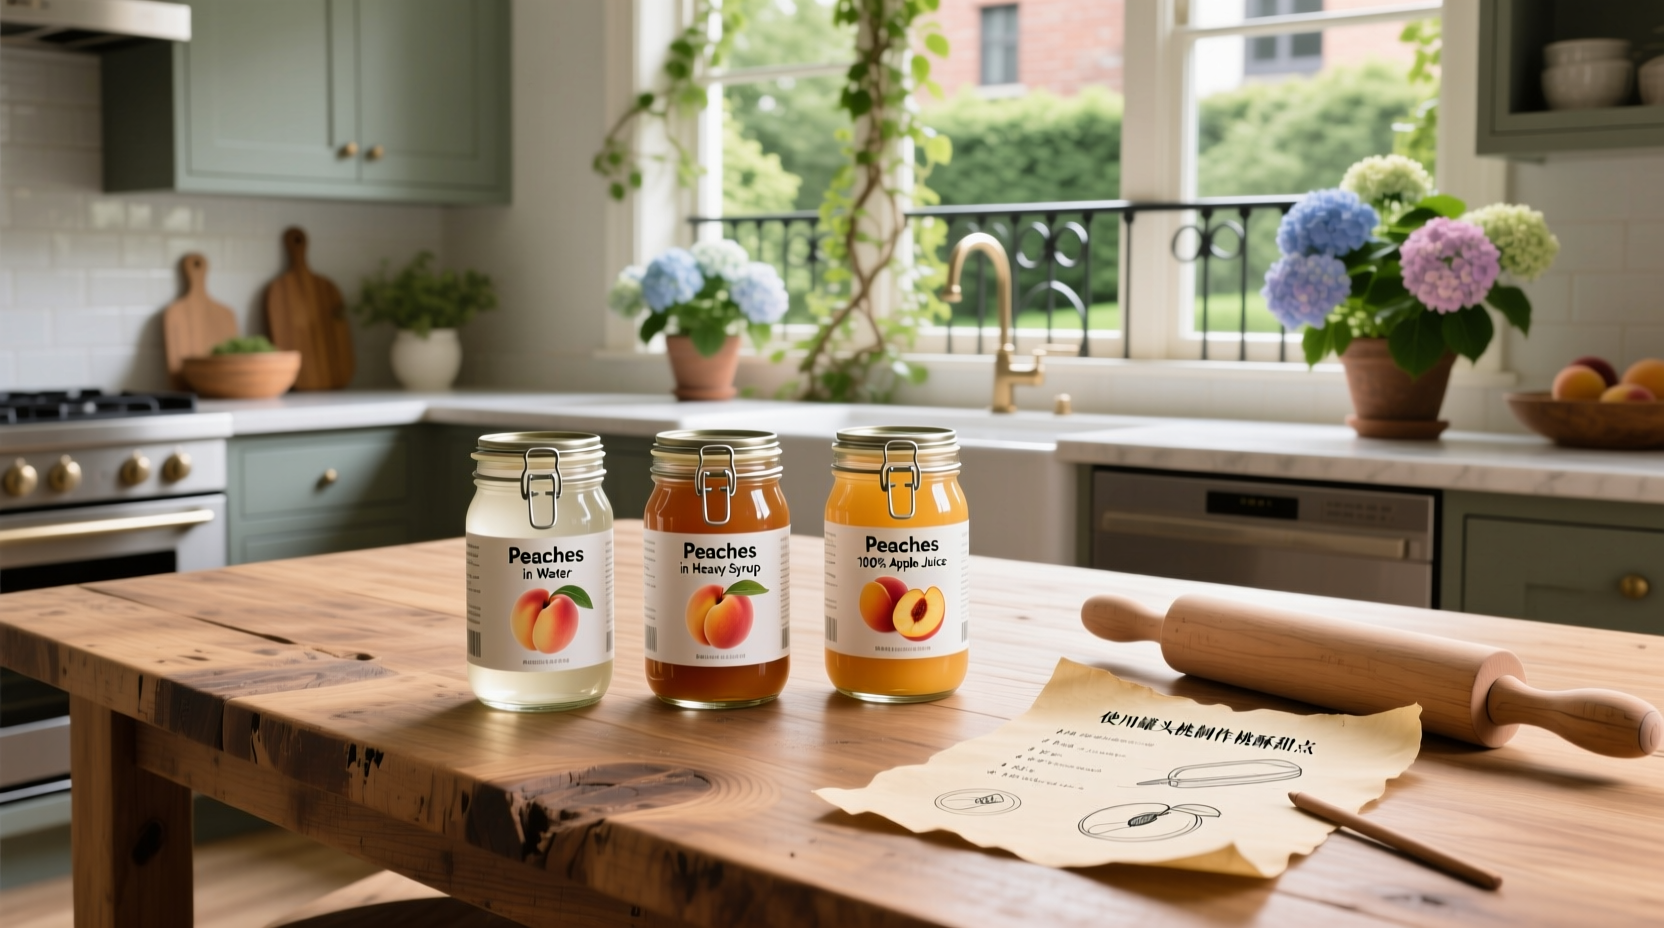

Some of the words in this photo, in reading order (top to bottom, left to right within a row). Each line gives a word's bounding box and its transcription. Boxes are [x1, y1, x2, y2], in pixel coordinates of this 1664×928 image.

[683, 542, 757, 559] Peaches
[866, 535, 939, 553] Peaches
[508, 546, 584, 564] Peaches
[857, 556, 886, 568] 100%
[921, 556, 947, 568] Juice
[522, 568, 533, 580] in
[537, 567, 572, 579] Water
[680, 562, 689, 574] in
[692, 563, 726, 577] Heavy
[728, 563, 761, 577] Syrup
